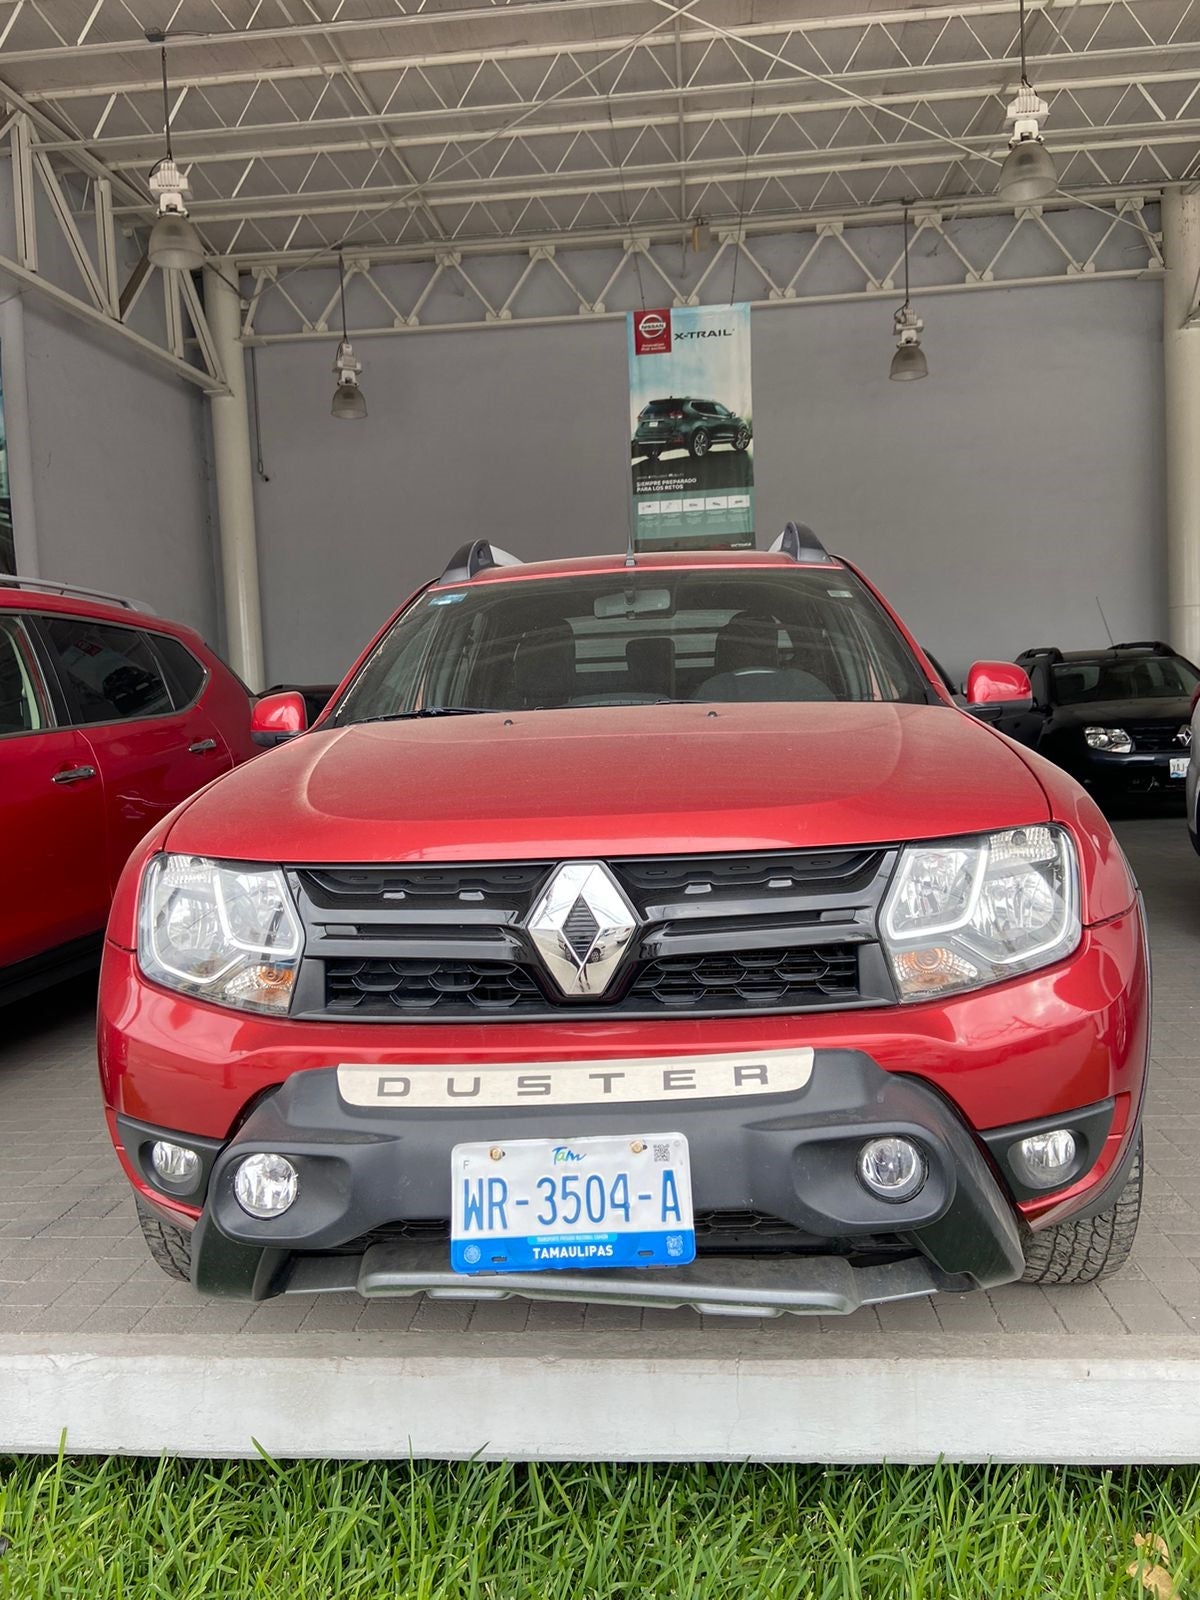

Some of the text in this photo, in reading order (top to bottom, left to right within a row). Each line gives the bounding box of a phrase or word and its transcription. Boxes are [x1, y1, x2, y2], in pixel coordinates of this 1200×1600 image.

[641, 322, 664, 330] NISSAN
[674, 329, 733, 341] X-TRAIL
[661, 478, 697, 486] PREPARADO
[376, 1063, 769, 1098] DUSTER
[463, 1169, 682, 1231] WR-3504-A
[532, 1244, 614, 1260] TAMAULIPAS
